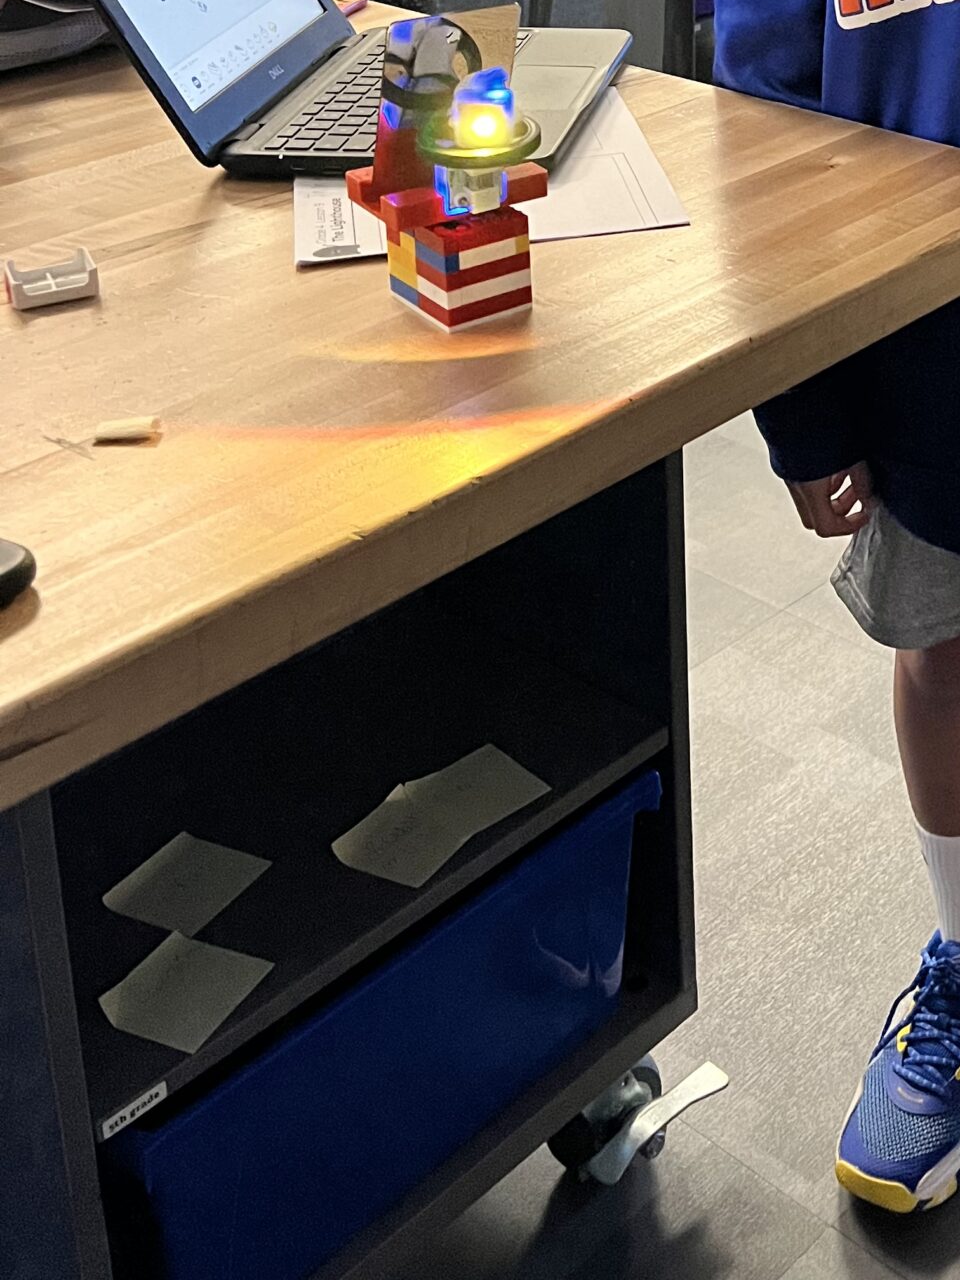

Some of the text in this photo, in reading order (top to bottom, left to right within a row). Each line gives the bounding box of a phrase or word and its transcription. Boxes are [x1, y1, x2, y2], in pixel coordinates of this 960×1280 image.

[330, 198, 346, 242] The Lighthouse
[129, 1091, 160, 1119] grade
